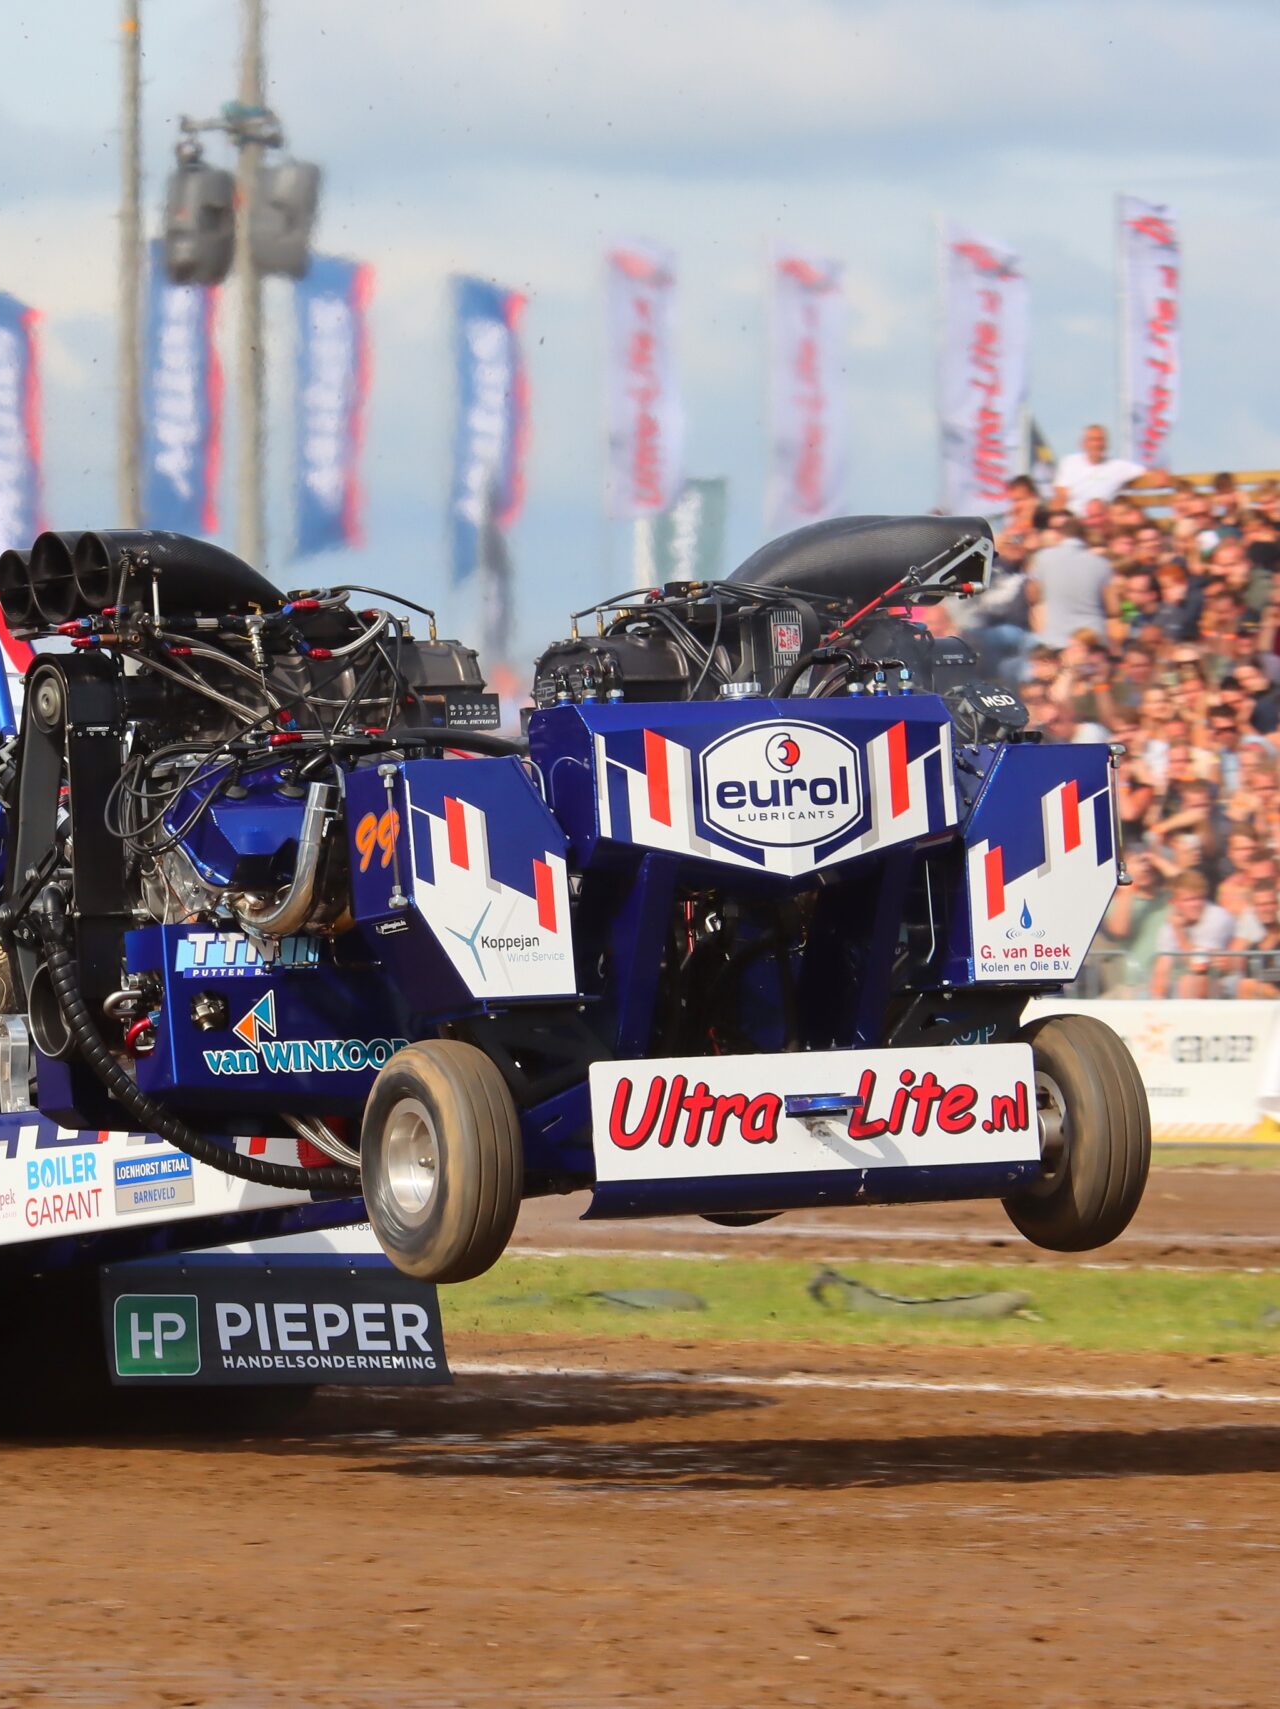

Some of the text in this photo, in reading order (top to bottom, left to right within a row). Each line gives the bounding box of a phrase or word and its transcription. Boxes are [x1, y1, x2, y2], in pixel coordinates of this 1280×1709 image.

[980, 693, 1015, 708] MSD
[715, 766, 850, 809] eurol
[737, 809, 836, 823] LUBRICANTS
[481, 934, 540, 952] Koppejan
[980, 943, 1071, 960] G. van Beek
[507, 951, 565, 962] Wind Service
[191, 967, 246, 977] PUTTEN
[981, 960, 1072, 973] Kolen en Olie B.V.
[203, 1050, 259, 1075] van
[608, 1068, 1030, 1152] Ultra Lite.nl
[26, 1152, 98, 1191] BOILER
[116, 1157, 190, 1181] LOENHORST METAAL
[133, 1186, 176, 1205] BARNEVELD
[25, 1188, 103, 1228] GARANT
[130, 1312, 187, 1360] HP
[214, 1302, 434, 1353] PIEPER
[222, 1355, 438, 1371] HANDELSONDERNEMING
